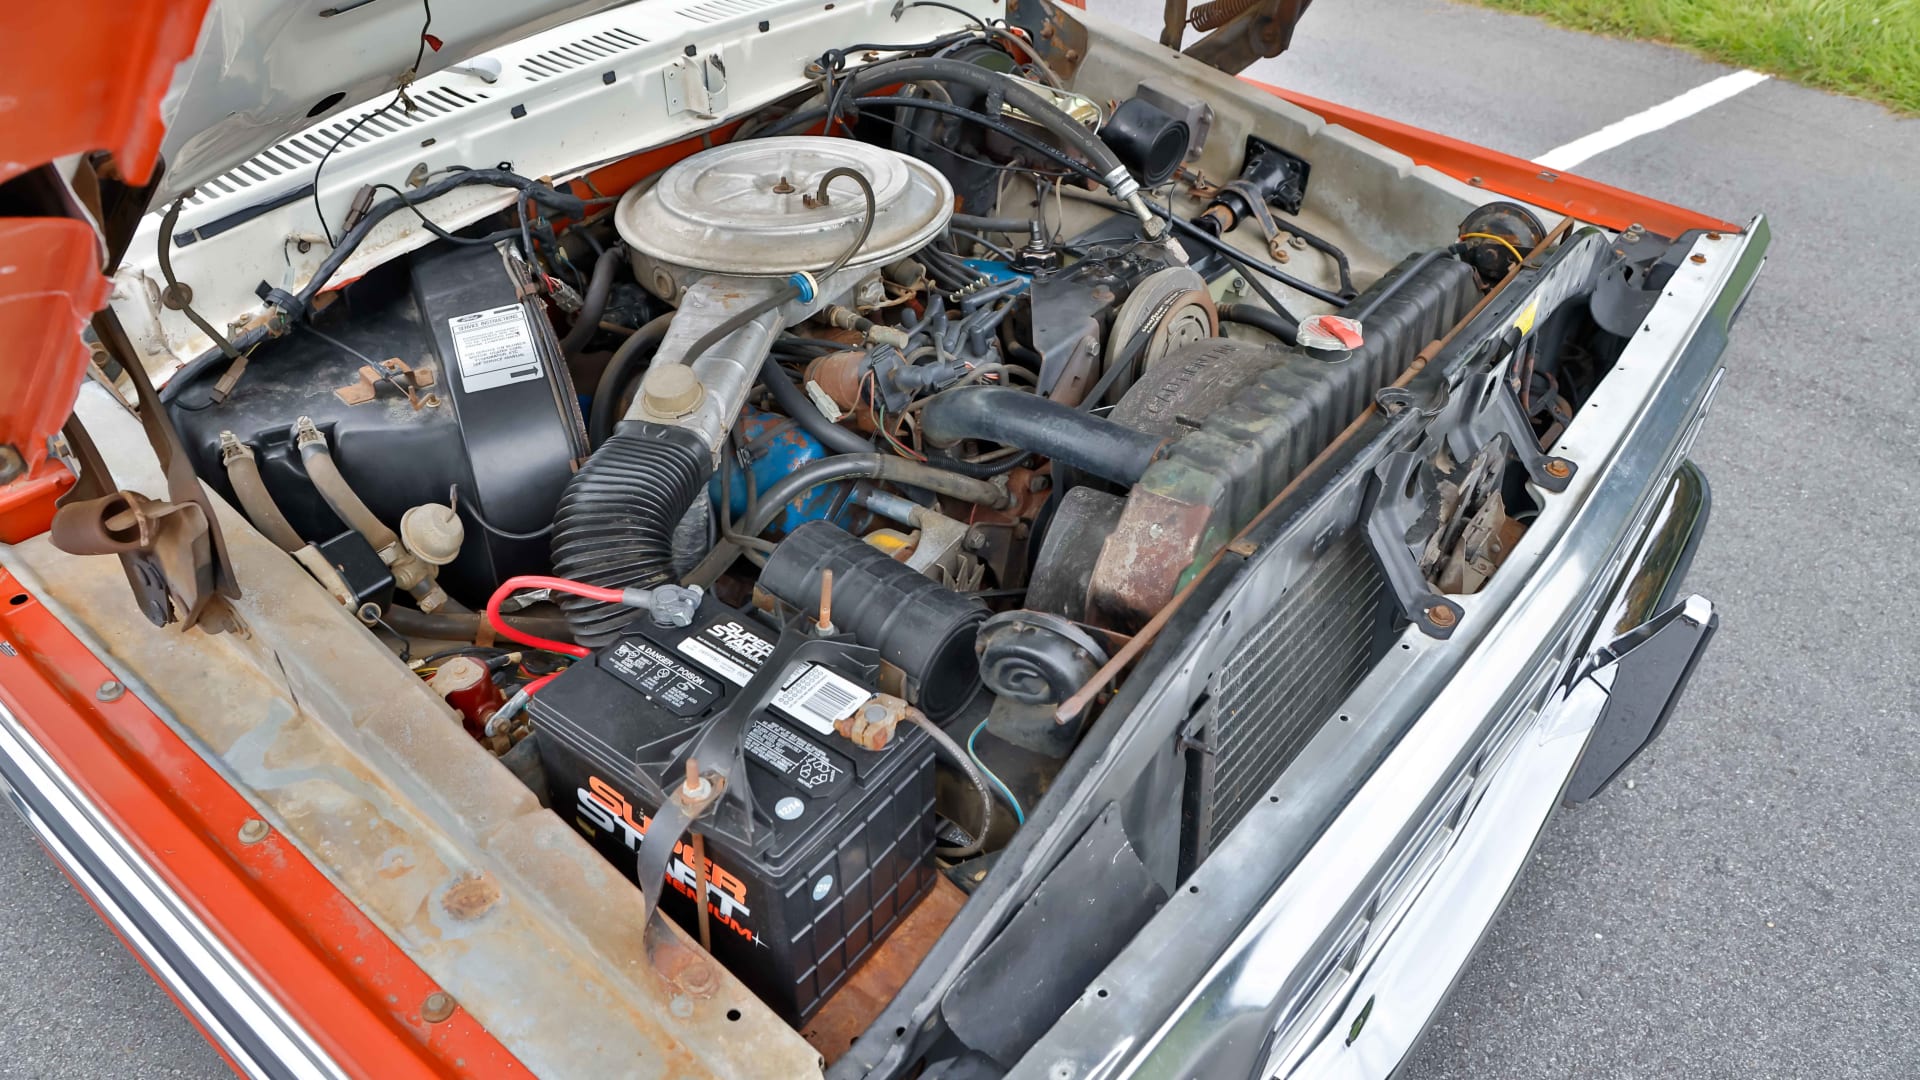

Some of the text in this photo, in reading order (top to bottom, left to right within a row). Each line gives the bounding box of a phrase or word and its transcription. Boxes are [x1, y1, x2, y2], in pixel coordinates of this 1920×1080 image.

[706, 624, 770, 659] START
[724, 622, 775, 654] SUPER
[644, 647, 674, 666] DANGER
[676, 666, 705, 684] POISON
[577, 788, 750, 917] STRT
[589, 776, 747, 904] SUER
